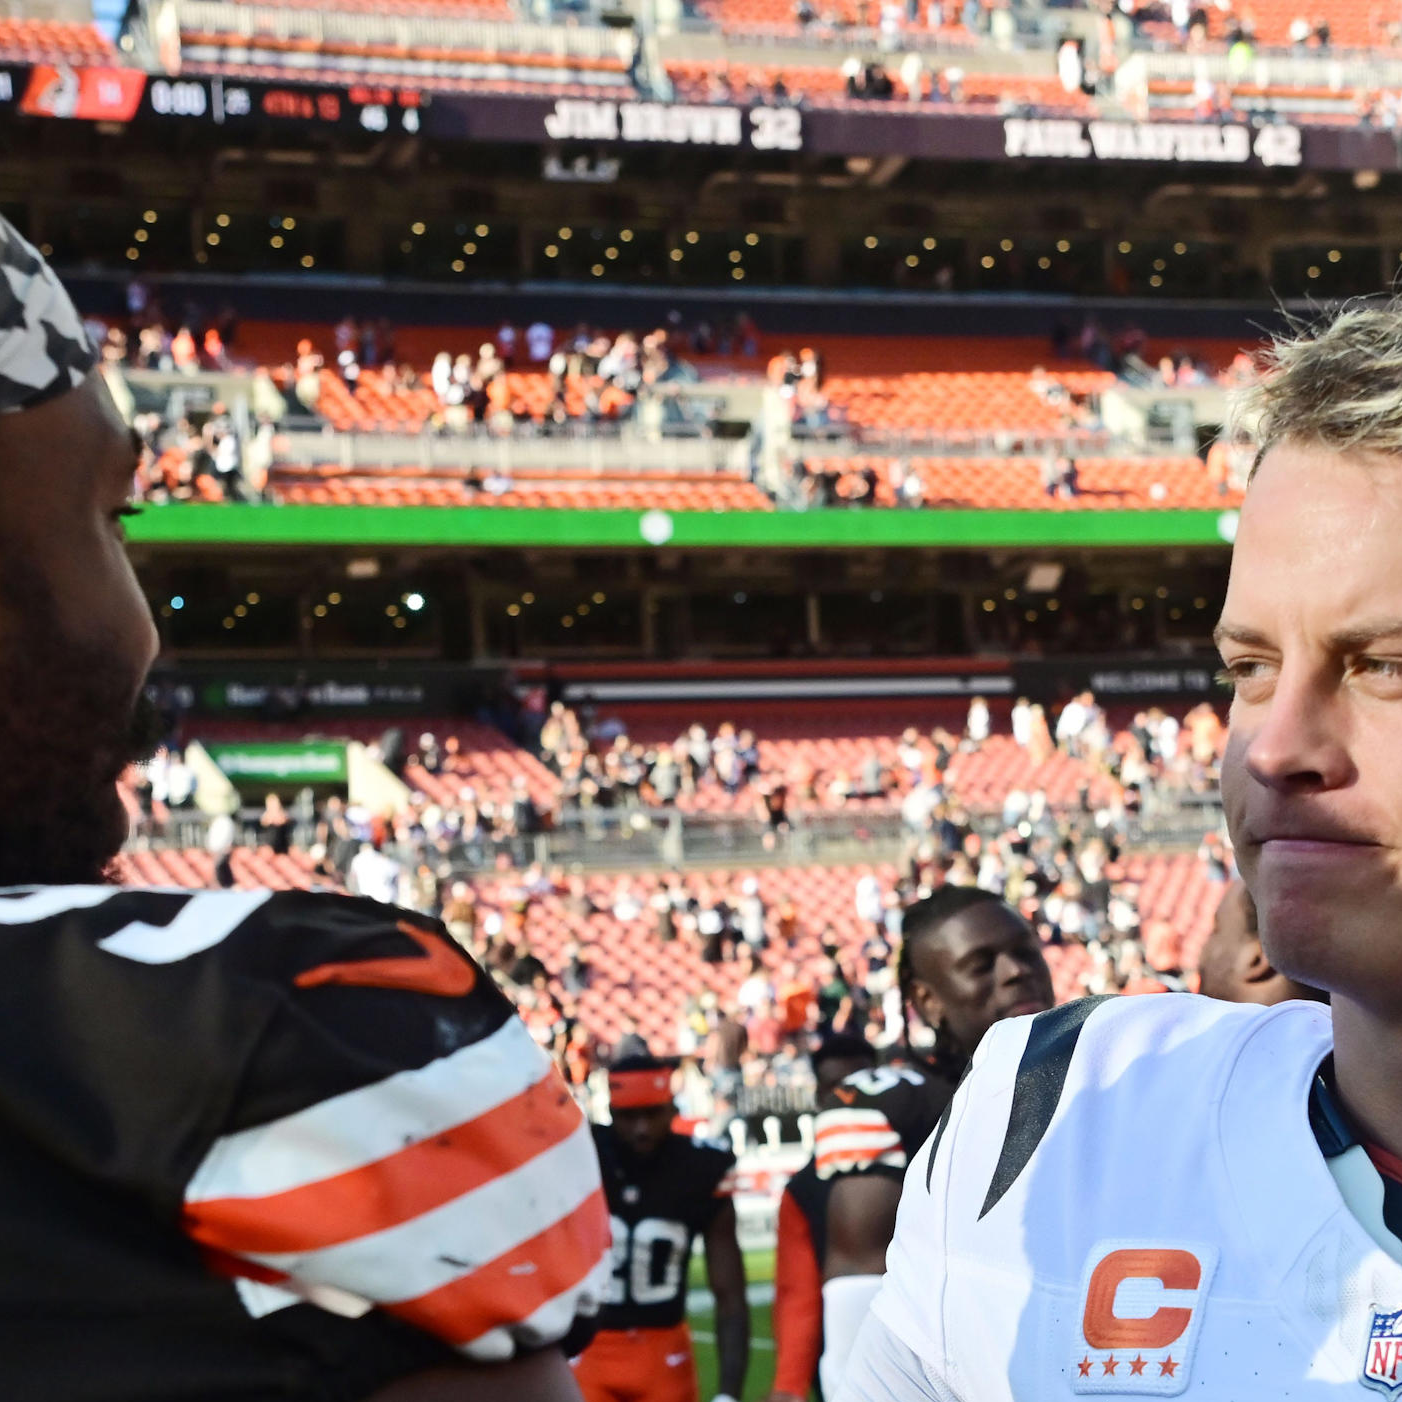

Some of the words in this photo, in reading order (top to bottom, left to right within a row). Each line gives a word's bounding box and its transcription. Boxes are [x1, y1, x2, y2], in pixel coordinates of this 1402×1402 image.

[750, 105, 803, 151] 32
[1253, 124, 1302, 167] 42
[1082, 1248, 1201, 1349] C
